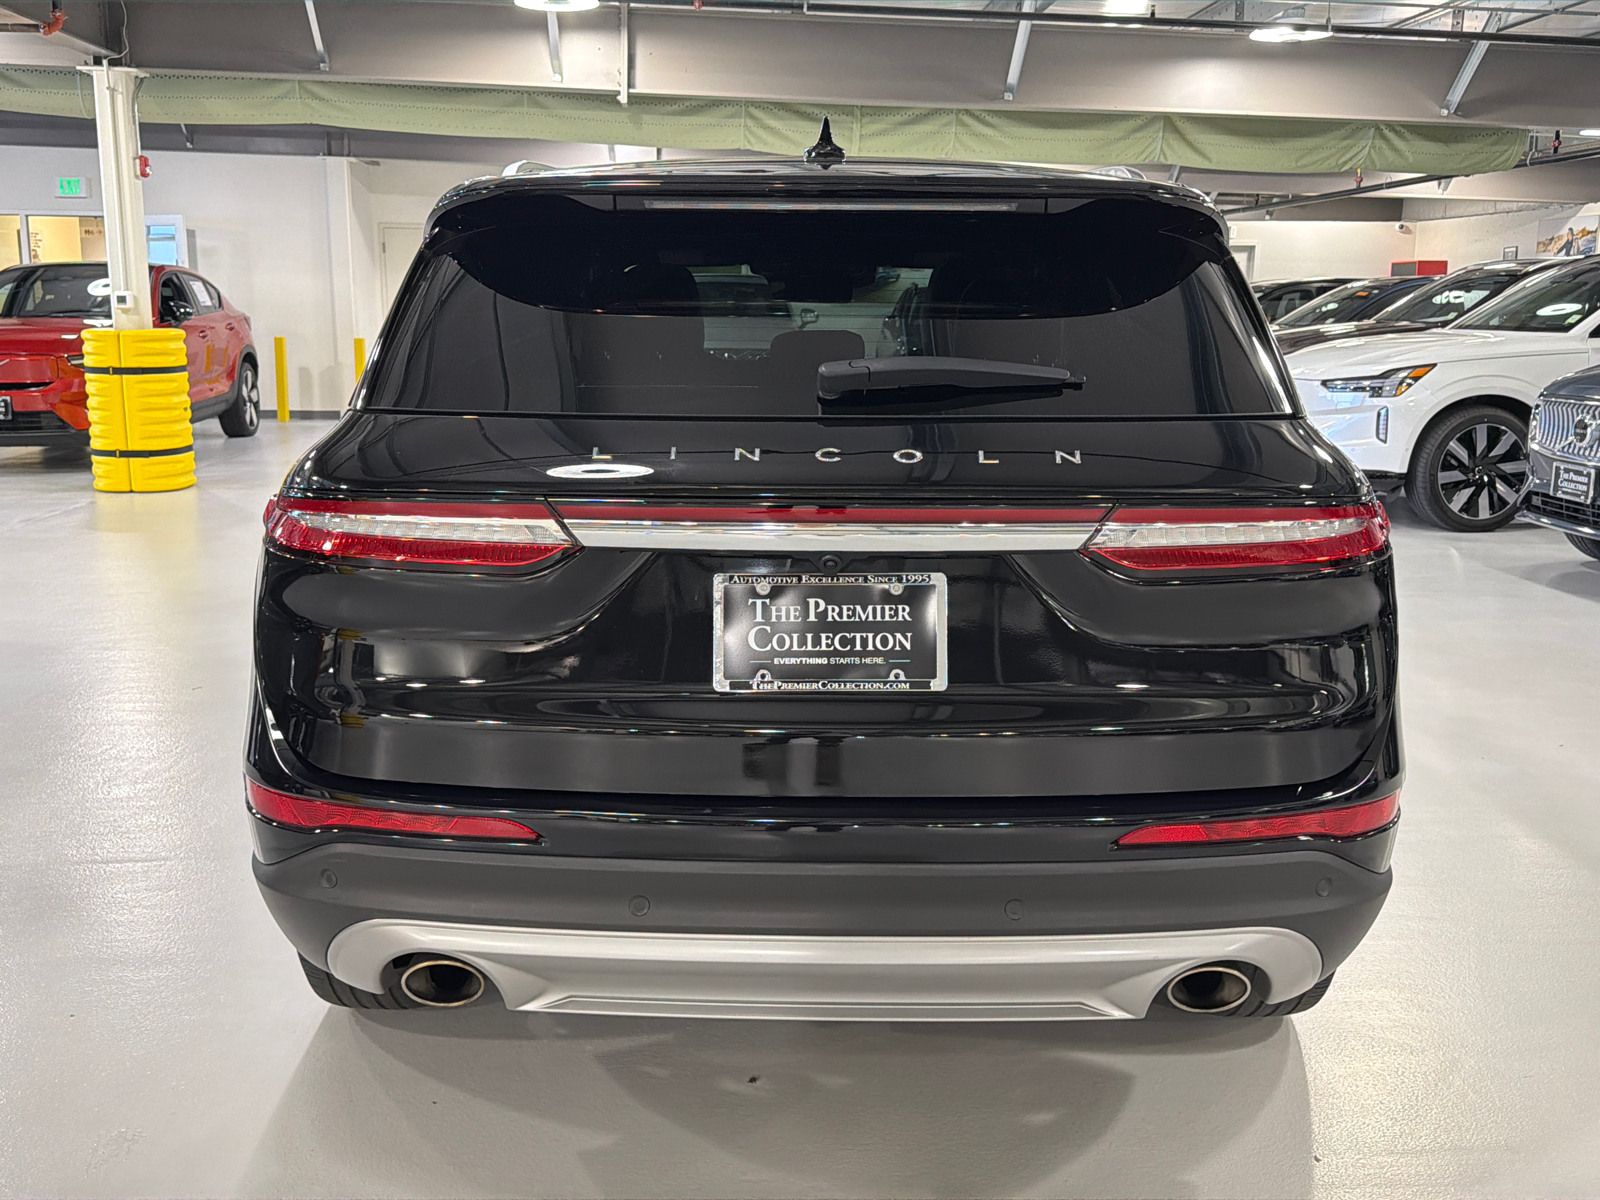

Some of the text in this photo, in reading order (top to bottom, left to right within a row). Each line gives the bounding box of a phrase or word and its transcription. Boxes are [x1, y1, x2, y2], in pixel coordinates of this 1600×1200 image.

[592, 446, 1082, 465] LINCOLN
[730, 573, 930, 584] AUTOMOTIVE EXCELLENCE SINCE 1995
[748, 598, 912, 622] THE PREMIER
[747, 625, 913, 651] COLLECTION
[773, 657, 887, 665] EVERYTHING STARTS HERE.
